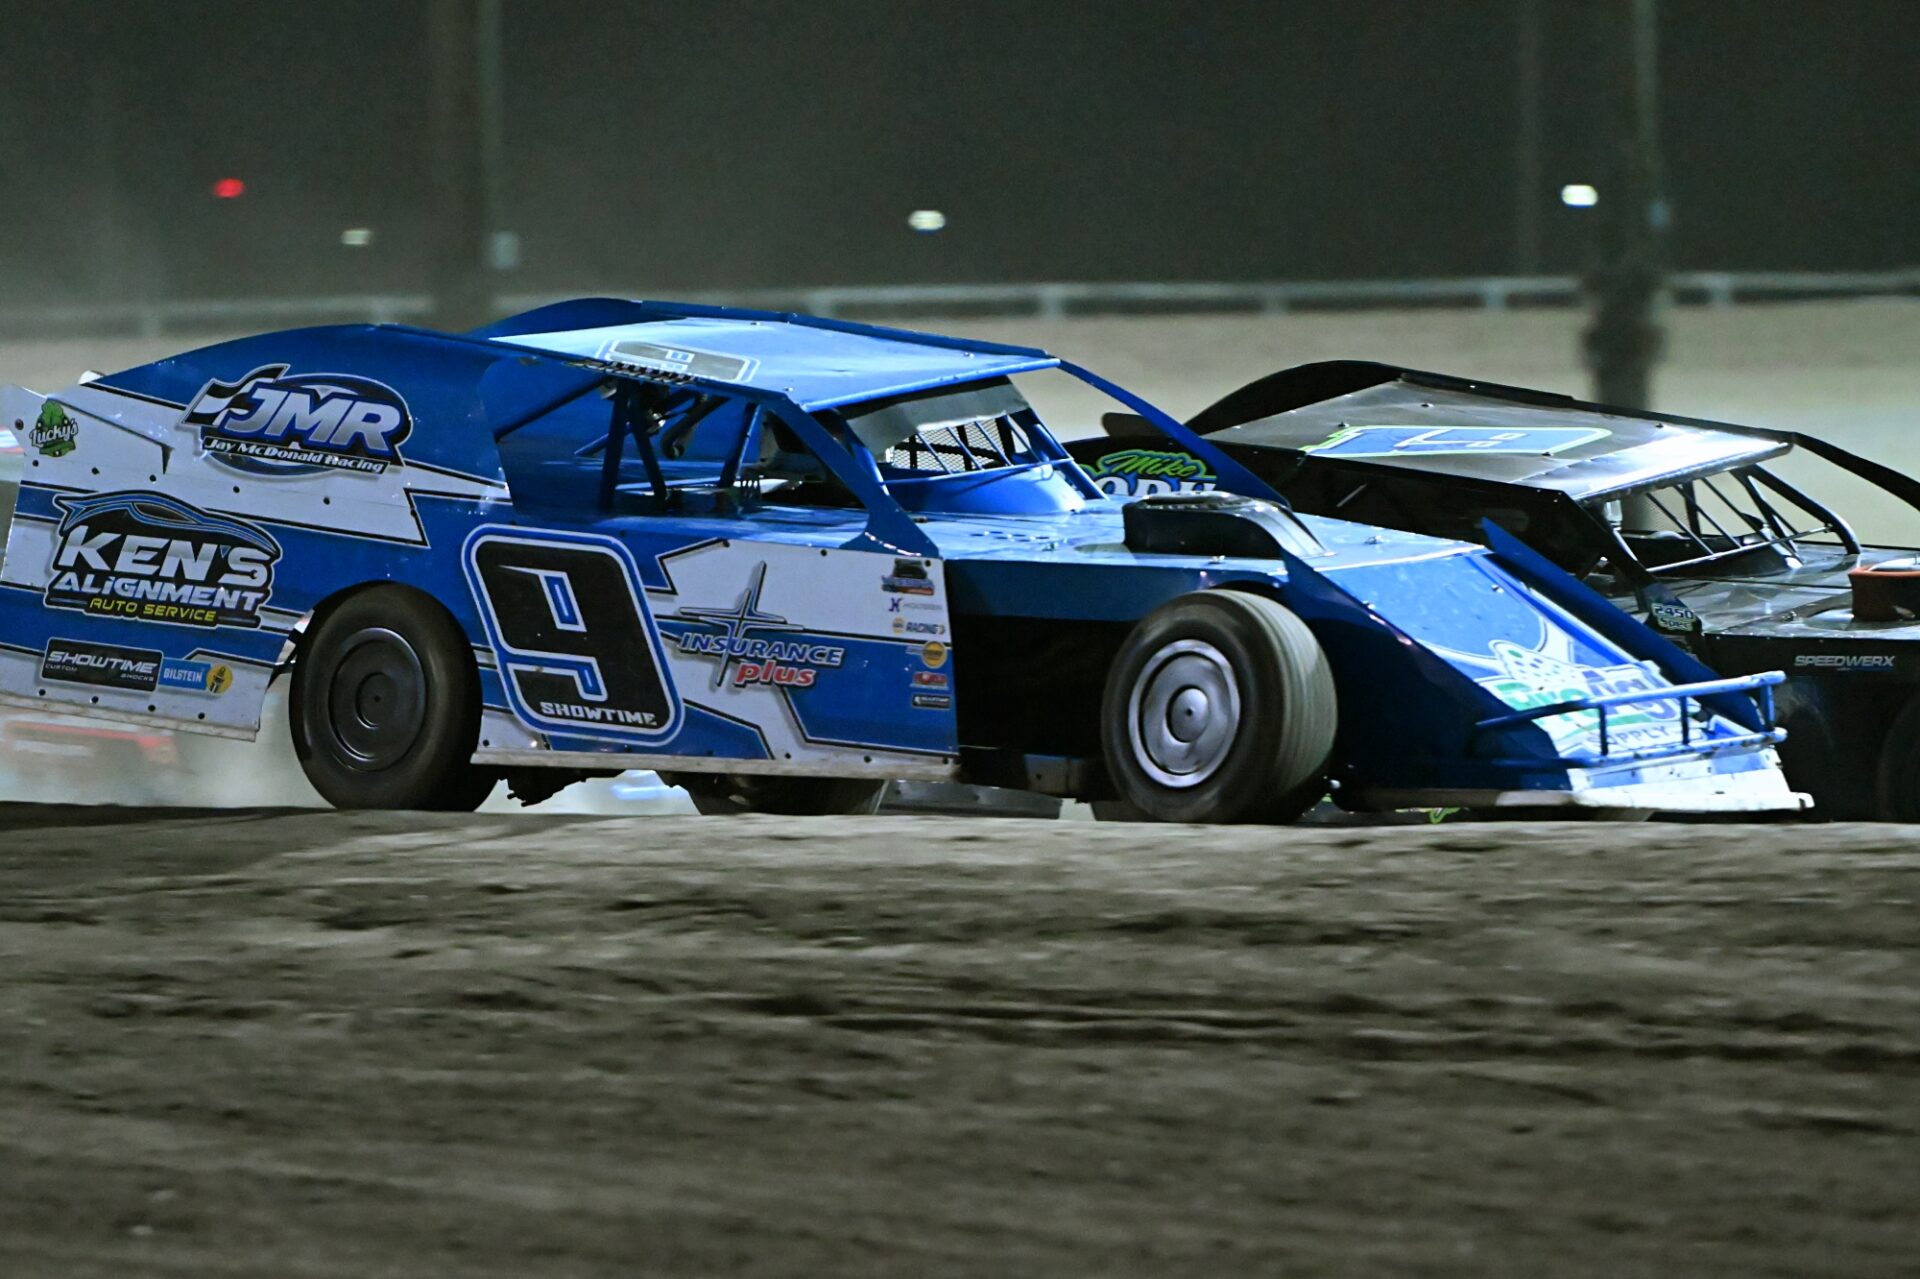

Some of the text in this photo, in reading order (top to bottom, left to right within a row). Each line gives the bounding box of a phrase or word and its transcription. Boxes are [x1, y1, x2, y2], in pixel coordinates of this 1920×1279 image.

[29, 417, 78, 448] Lucky's
[224, 387, 400, 452] JMR
[204, 438, 385, 473] Jay McDonald Racing
[1105, 454, 1198, 477] Mike
[57, 525, 272, 588] KEN'S
[89, 598, 217, 622] AUTO SERVICE
[1653, 604, 1694, 620] 2450
[470, 535, 676, 735] 9
[47, 650, 158, 674] SHOWTIME
[680, 631, 846, 667] INSURANCE
[1794, 655, 1896, 667] SPEEDWERX
[45, 663, 78, 673] CUSTOM
[163, 669, 204, 683] BILSTEIN
[735, 660, 816, 687] plus
[540, 700, 659, 727] SHOWTIME
